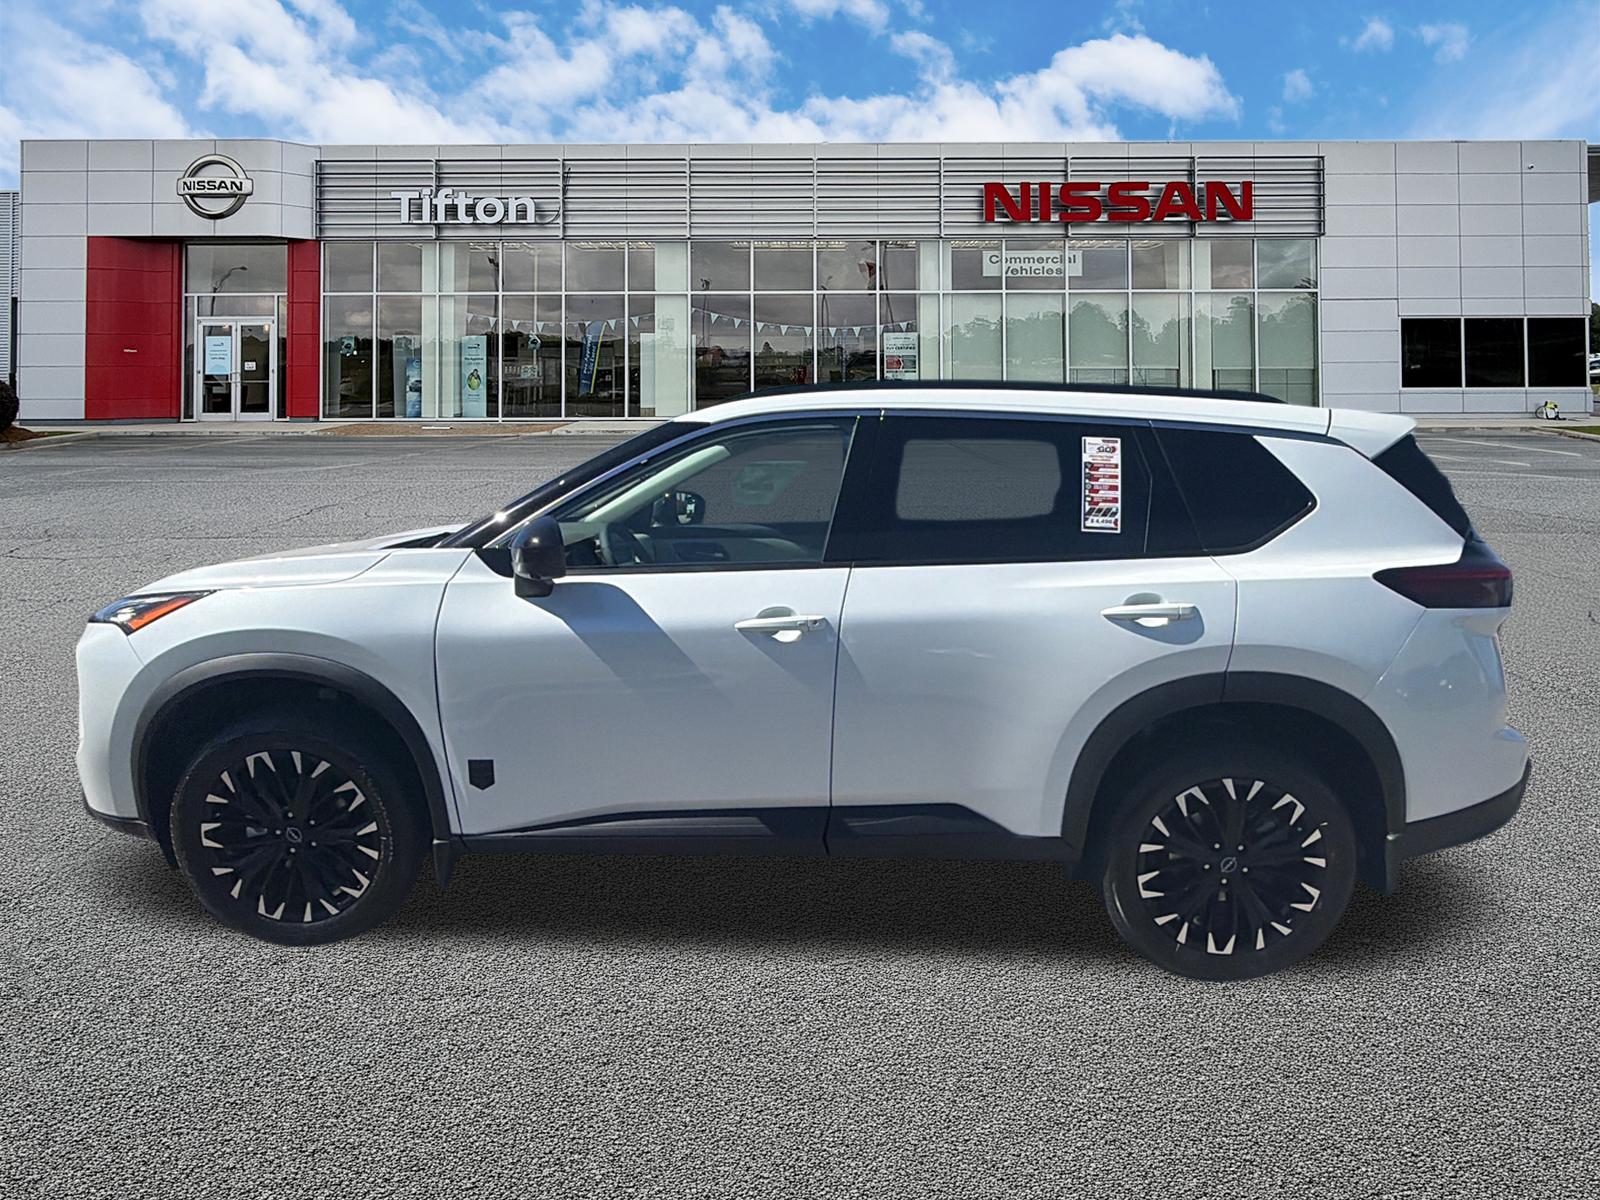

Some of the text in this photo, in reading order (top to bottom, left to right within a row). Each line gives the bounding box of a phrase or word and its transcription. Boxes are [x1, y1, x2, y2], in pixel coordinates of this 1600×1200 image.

[183, 180, 243, 191] NISSAN
[983, 181, 1254, 223] NISSAN
[391, 188, 536, 224] Tifton
